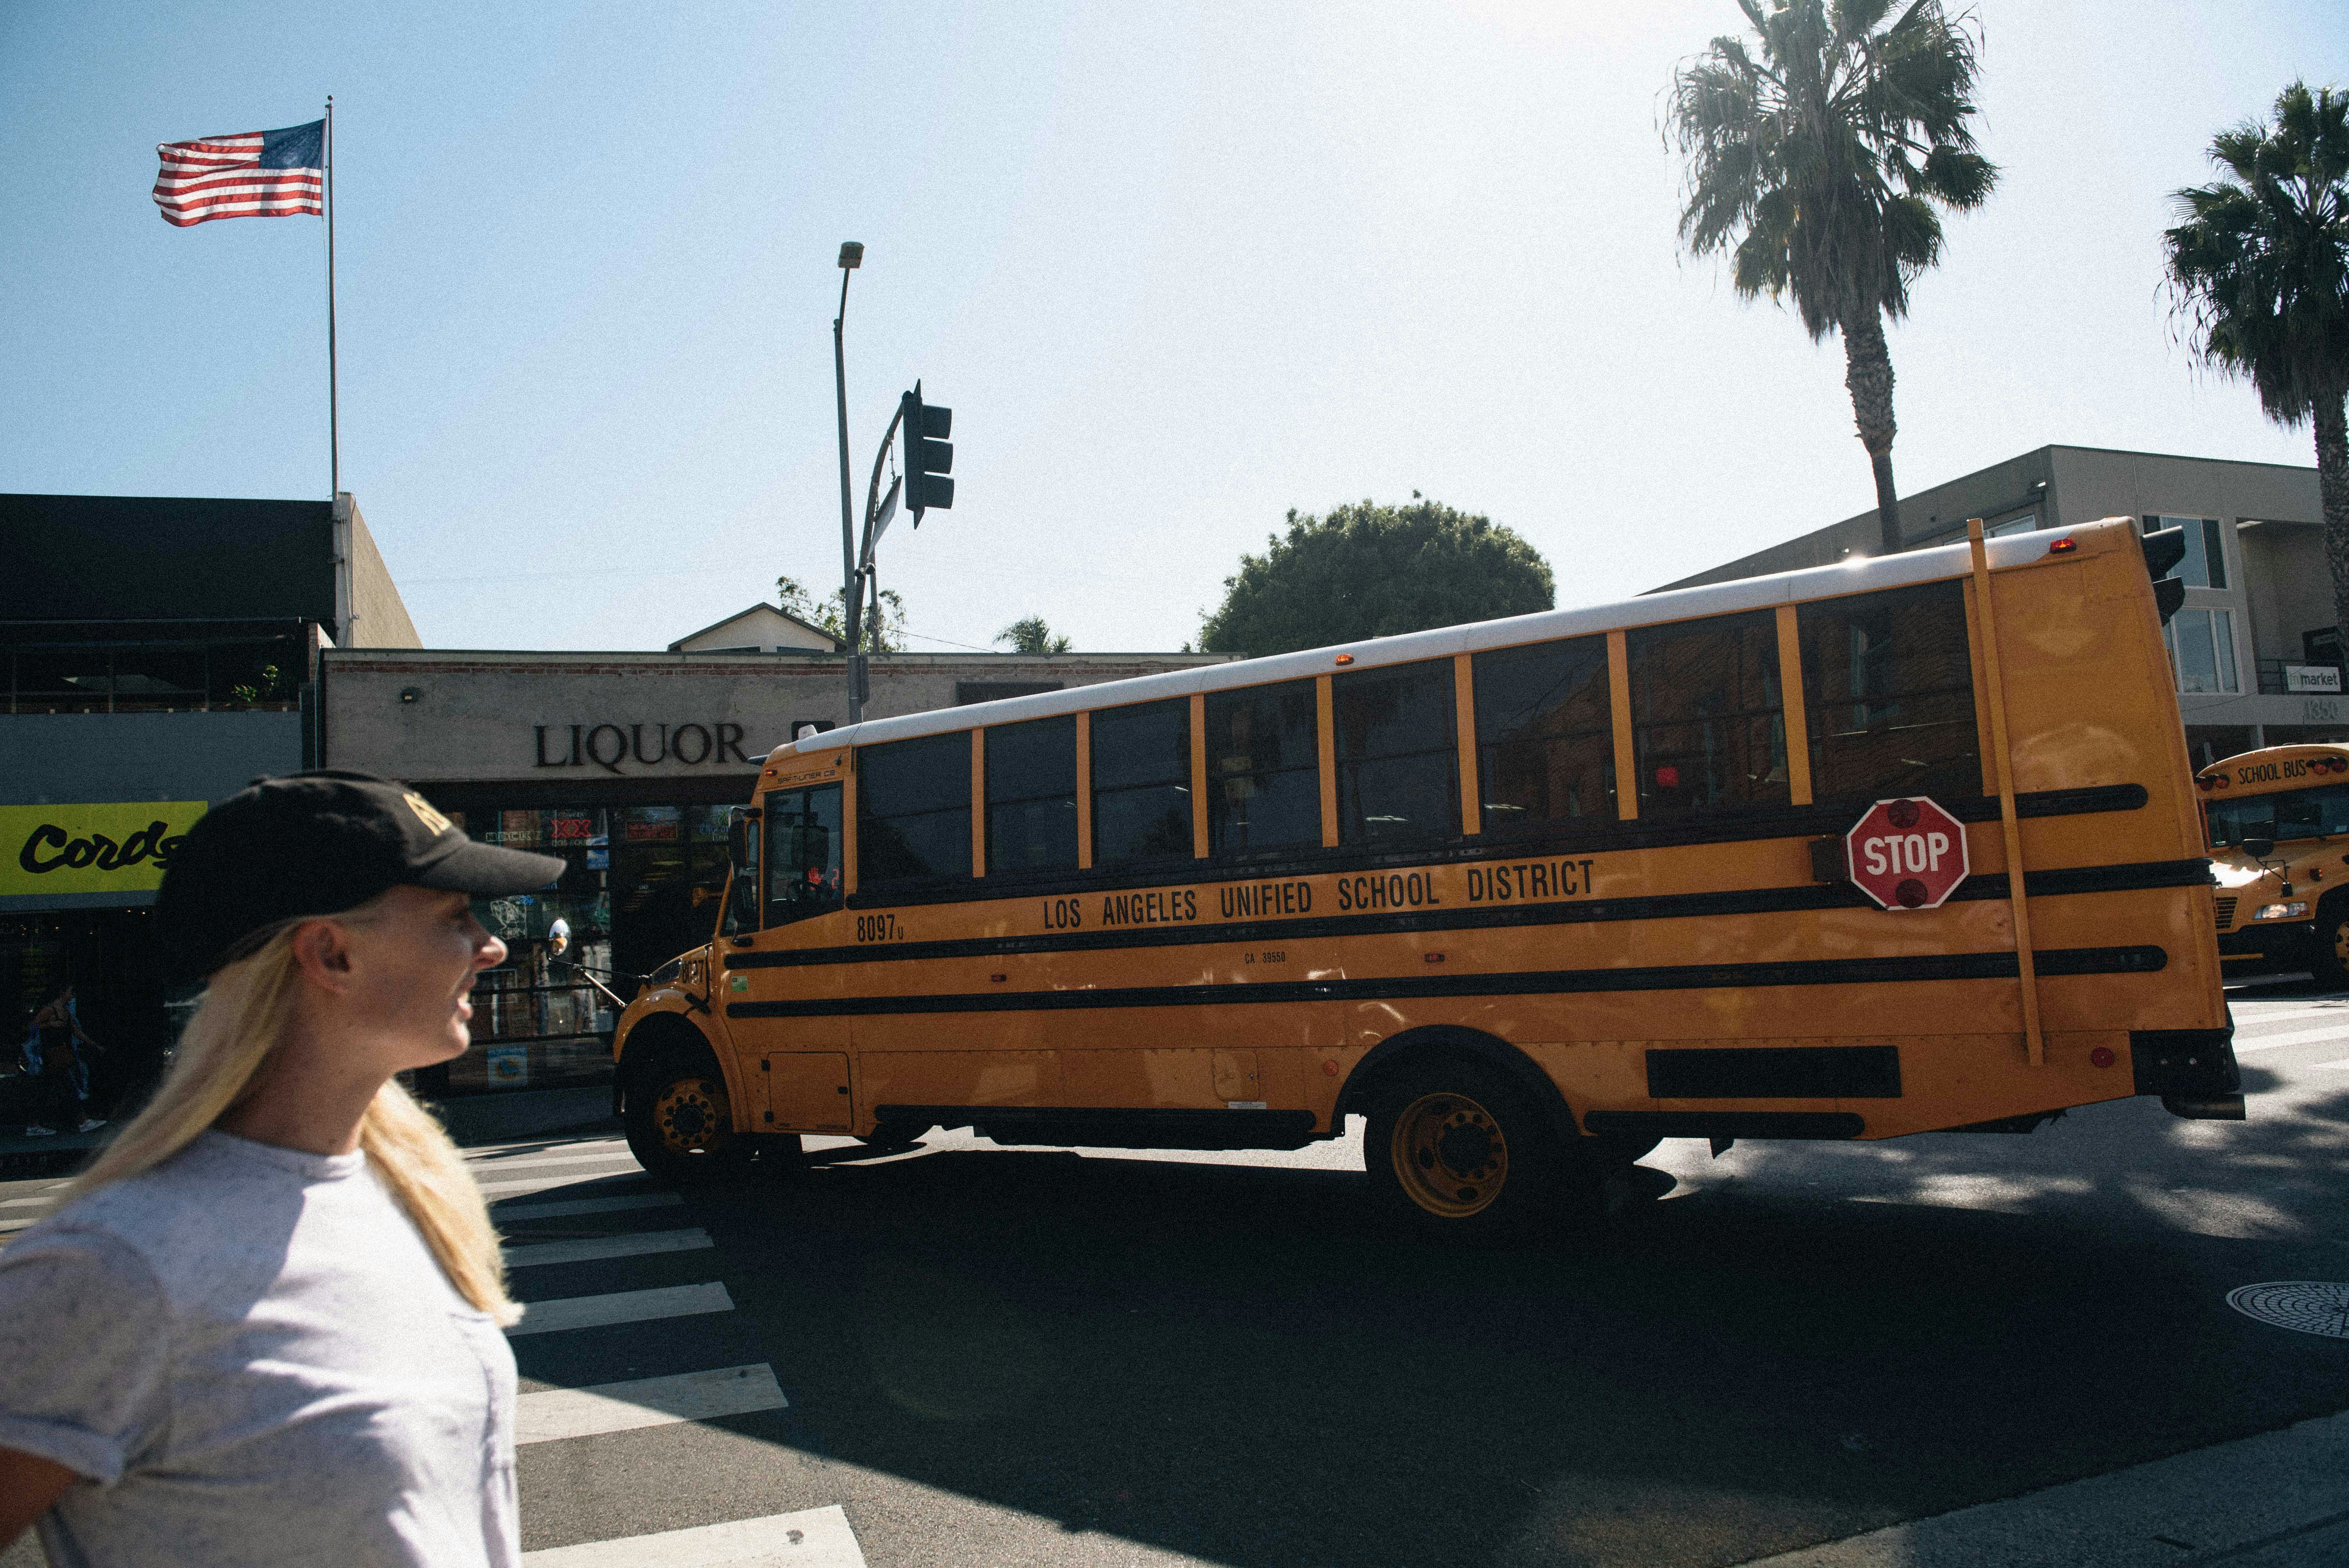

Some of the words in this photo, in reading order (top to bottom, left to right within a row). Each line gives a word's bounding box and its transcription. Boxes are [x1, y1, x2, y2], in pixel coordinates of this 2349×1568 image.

[533, 723, 749, 774] LIQUOR
[2239, 763, 2281, 784] SCHOOL
[2284, 759, 2306, 779] BUS
[1864, 832, 1949, 876] STOP
[1044, 899, 1081, 929] LOS
[1103, 890, 1197, 925] ANGELES
[1221, 882, 1312, 918] UNIFIED
[1338, 873, 1440, 910] SCHOOL
[1468, 860, 1593, 902] DISTRICT
[857, 914, 895, 942] 8097
[1245, 953, 1255, 964] CA
[1262, 951, 1285, 963] 39550
